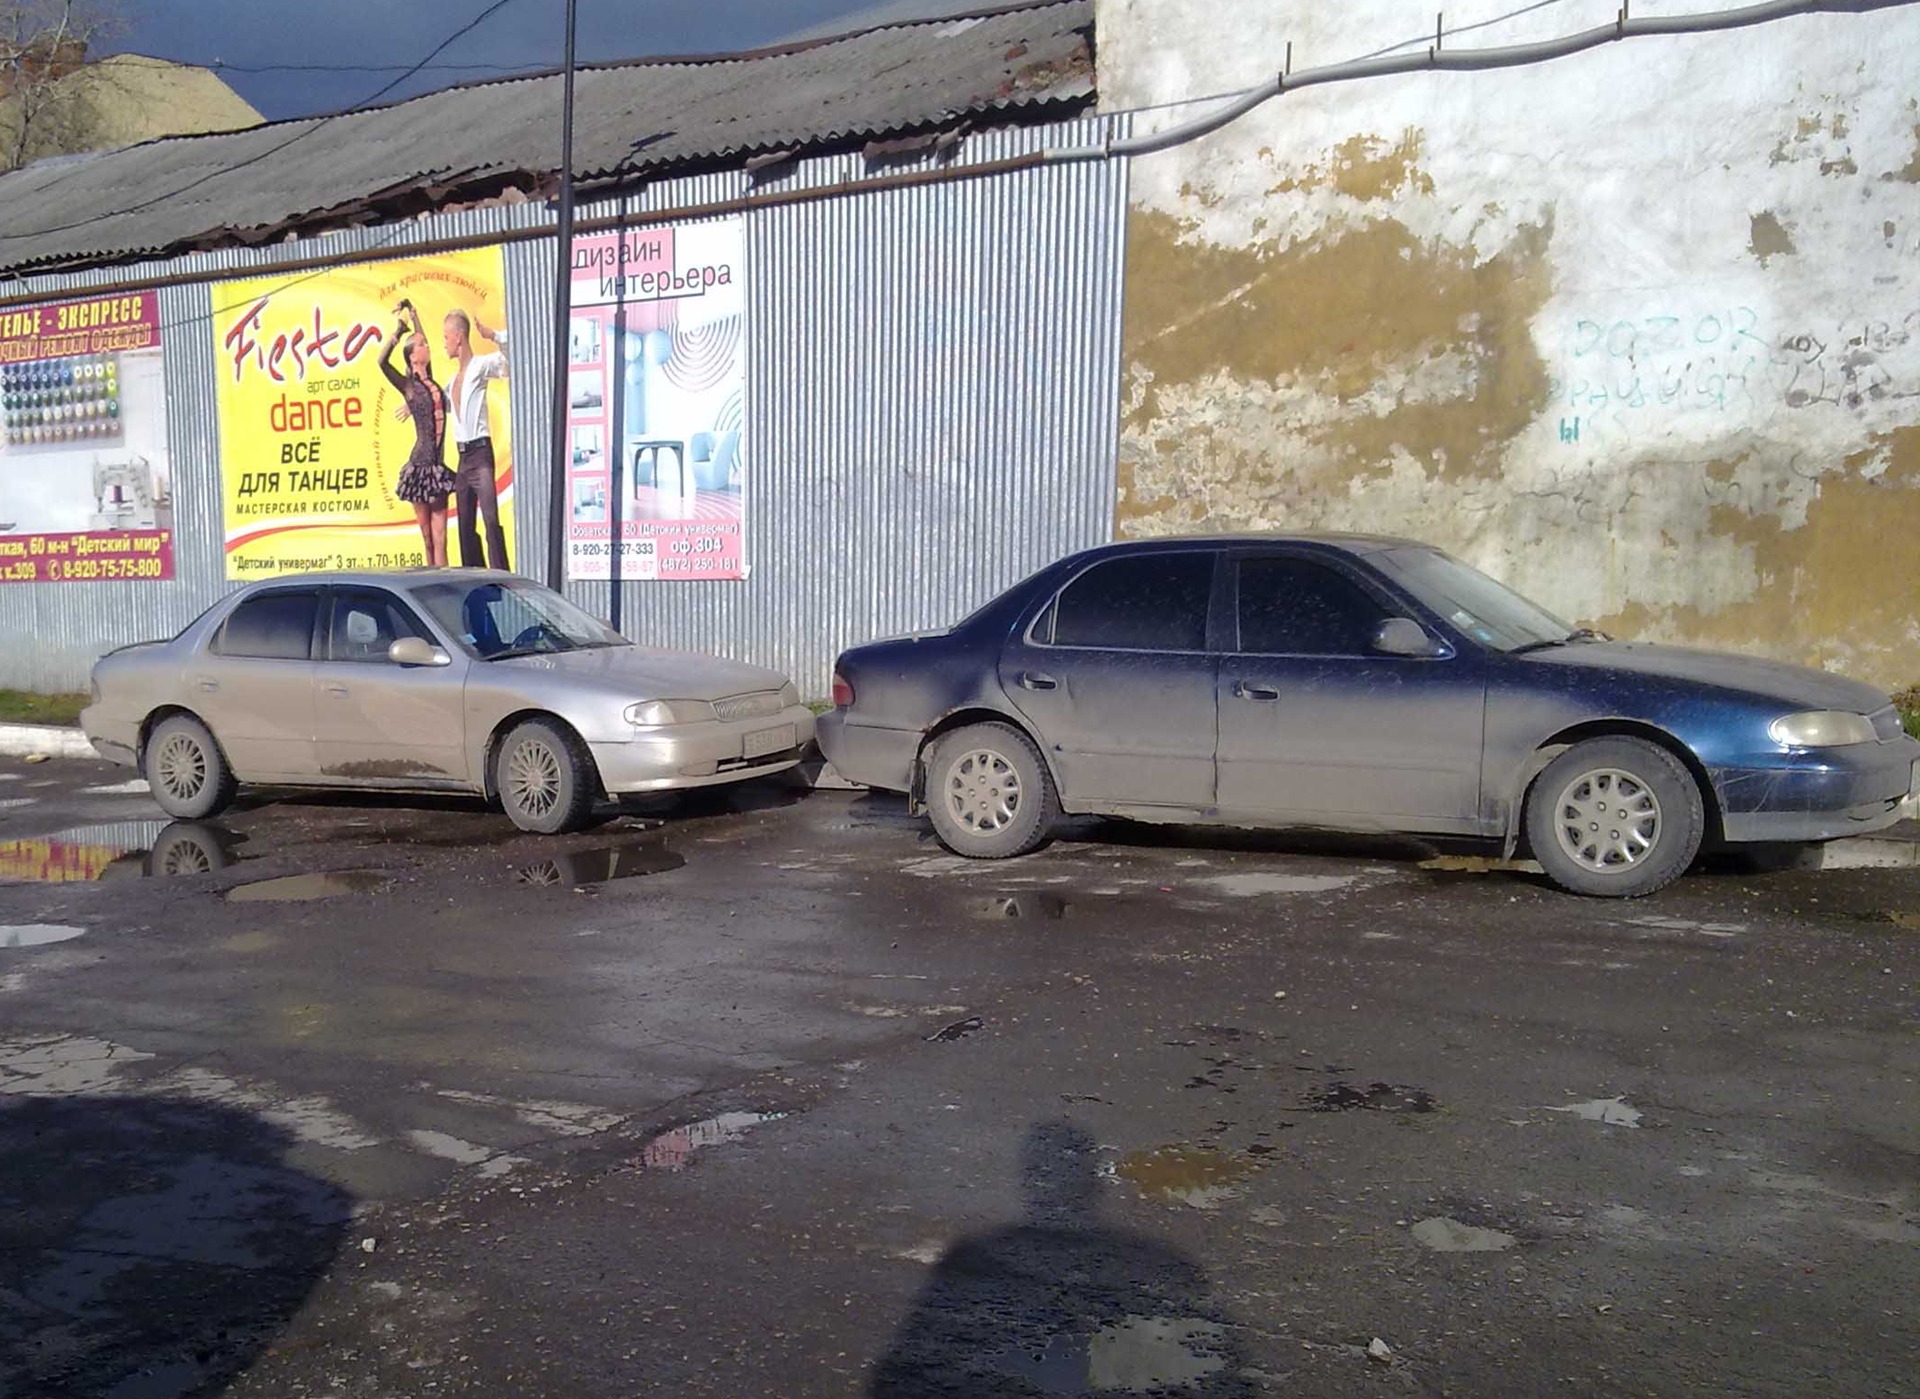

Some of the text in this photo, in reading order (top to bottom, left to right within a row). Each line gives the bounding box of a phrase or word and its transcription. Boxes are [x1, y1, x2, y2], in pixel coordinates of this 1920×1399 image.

[600, 263, 732, 299] интерьера
[58, 296, 142, 330] ЭКСПРЕСС
[0, 322, 152, 362] ЧНЫЙ РЕМОНТ ОДЕЖДЫ
[226, 297, 382, 382] Fiesta
[307, 378, 360, 394] арт салон
[270, 393, 363, 432] dance
[281, 437, 321, 464] ВСЁ
[238, 468, 369, 498] ДЛЯ ТАНЦЕВ
[236, 499, 370, 515] МАСТЕРСКАЯ КОСТЮМА
[30, 537, 45, 554] 60
[670, 537, 724, 556] оф.304
[63, 559, 162, 578] 8-920-75-75-800
[336, 554, 343, 569] 3
[367, 553, 423, 567] т.70-18-98
